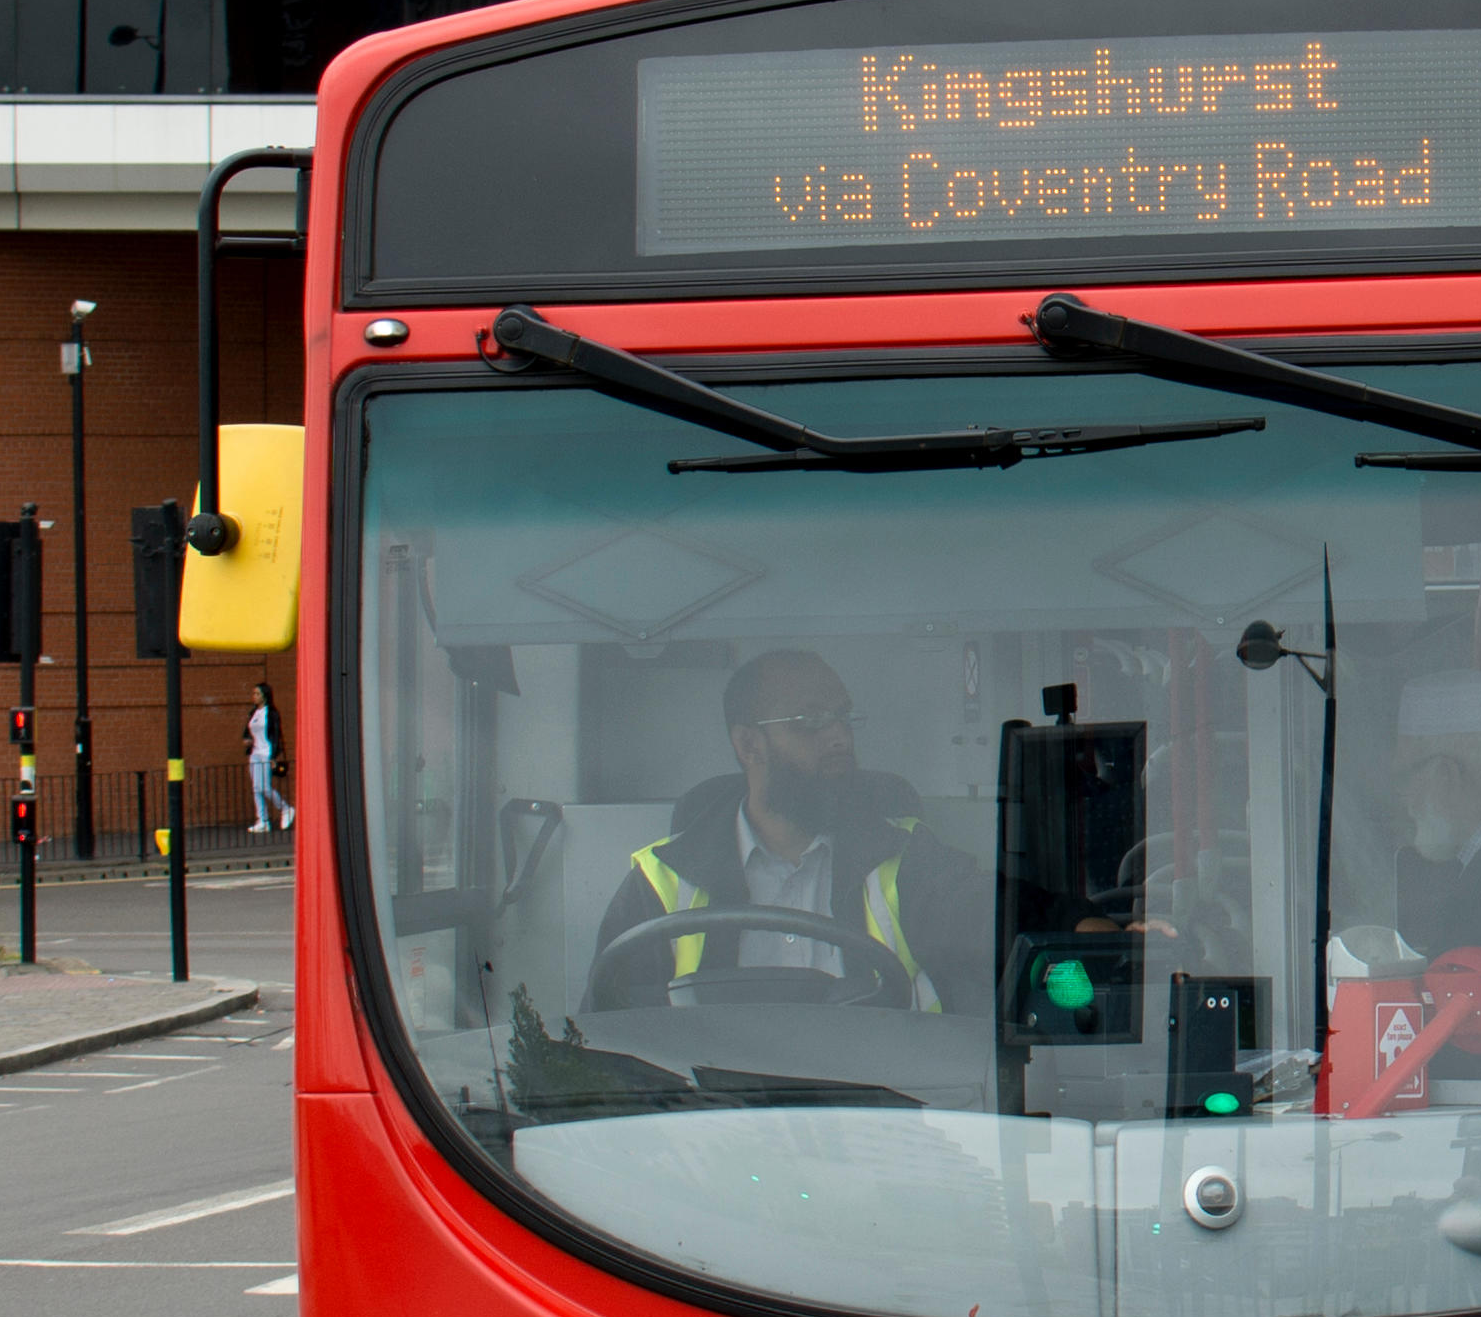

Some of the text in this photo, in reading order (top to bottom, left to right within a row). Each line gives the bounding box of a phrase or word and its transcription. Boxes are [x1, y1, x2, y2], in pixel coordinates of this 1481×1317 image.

[860, 41, 1339, 132] Kingshurst
[773, 137, 1431, 228] via Coventry Road
